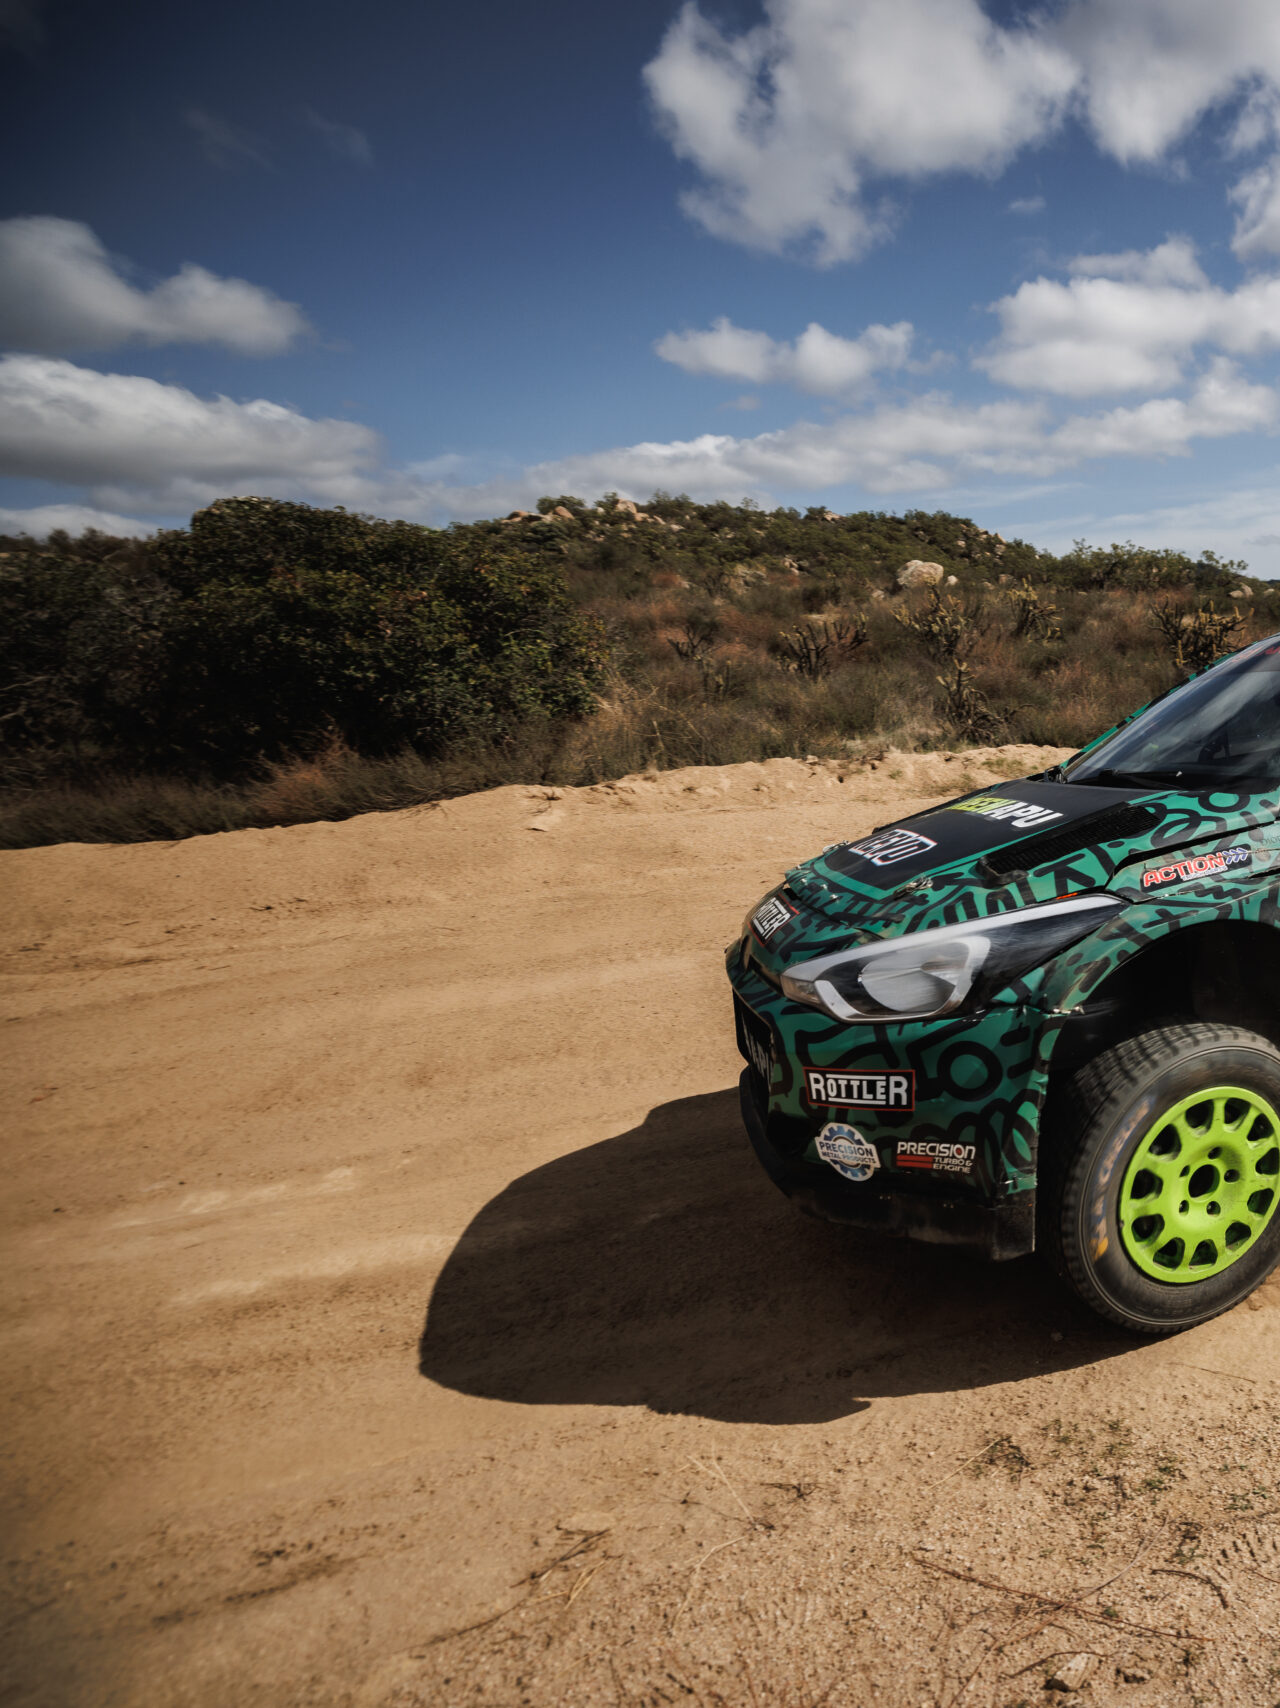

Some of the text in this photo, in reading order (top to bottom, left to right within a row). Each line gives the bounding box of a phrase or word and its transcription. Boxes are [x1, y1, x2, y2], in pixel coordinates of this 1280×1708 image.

[1143, 852, 1226, 888] ACTION
[808, 1072, 908, 1106] ROTTLER
[818, 1141, 874, 1158] PRECISION
[821, 1151, 876, 1165] METAL PRODUCTS
[896, 1141, 976, 1160] PRECISION
[932, 1163, 971, 1174] ENGINE
[933, 1156, 964, 1166] TURBO
